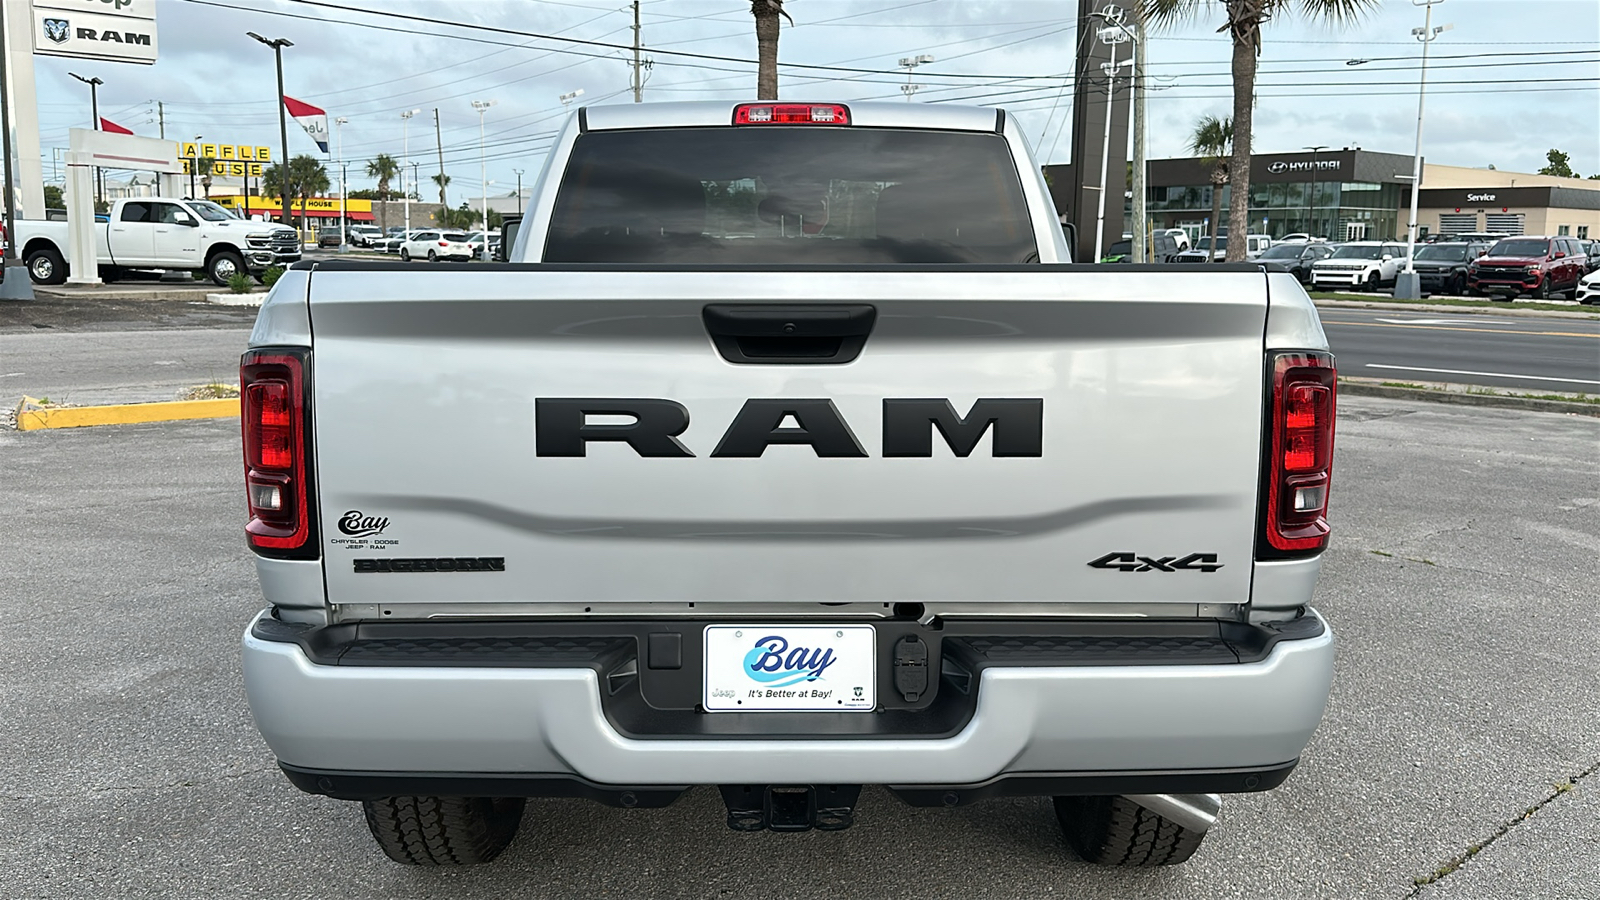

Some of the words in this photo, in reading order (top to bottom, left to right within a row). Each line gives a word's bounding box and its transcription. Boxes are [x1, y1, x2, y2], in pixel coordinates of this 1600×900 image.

[77, 27, 151, 46] RAM
[186, 145, 268, 159] AFFLE
[1289, 160, 1340, 172] HYUNDAI
[1467, 193, 1496, 202] Service
[534, 397, 1044, 458] RAM
[342, 510, 391, 536] Bay
[353, 556, 506, 573] BIGHORN
[1086, 551, 1226, 573] 4x4
[750, 635, 837, 682] Bay
[711, 688, 736, 699] Jeep
[748, 689, 763, 698] It's
[765, 689, 796, 698] Better
[798, 689, 808, 698] at
[811, 689, 833, 700] Bay!
